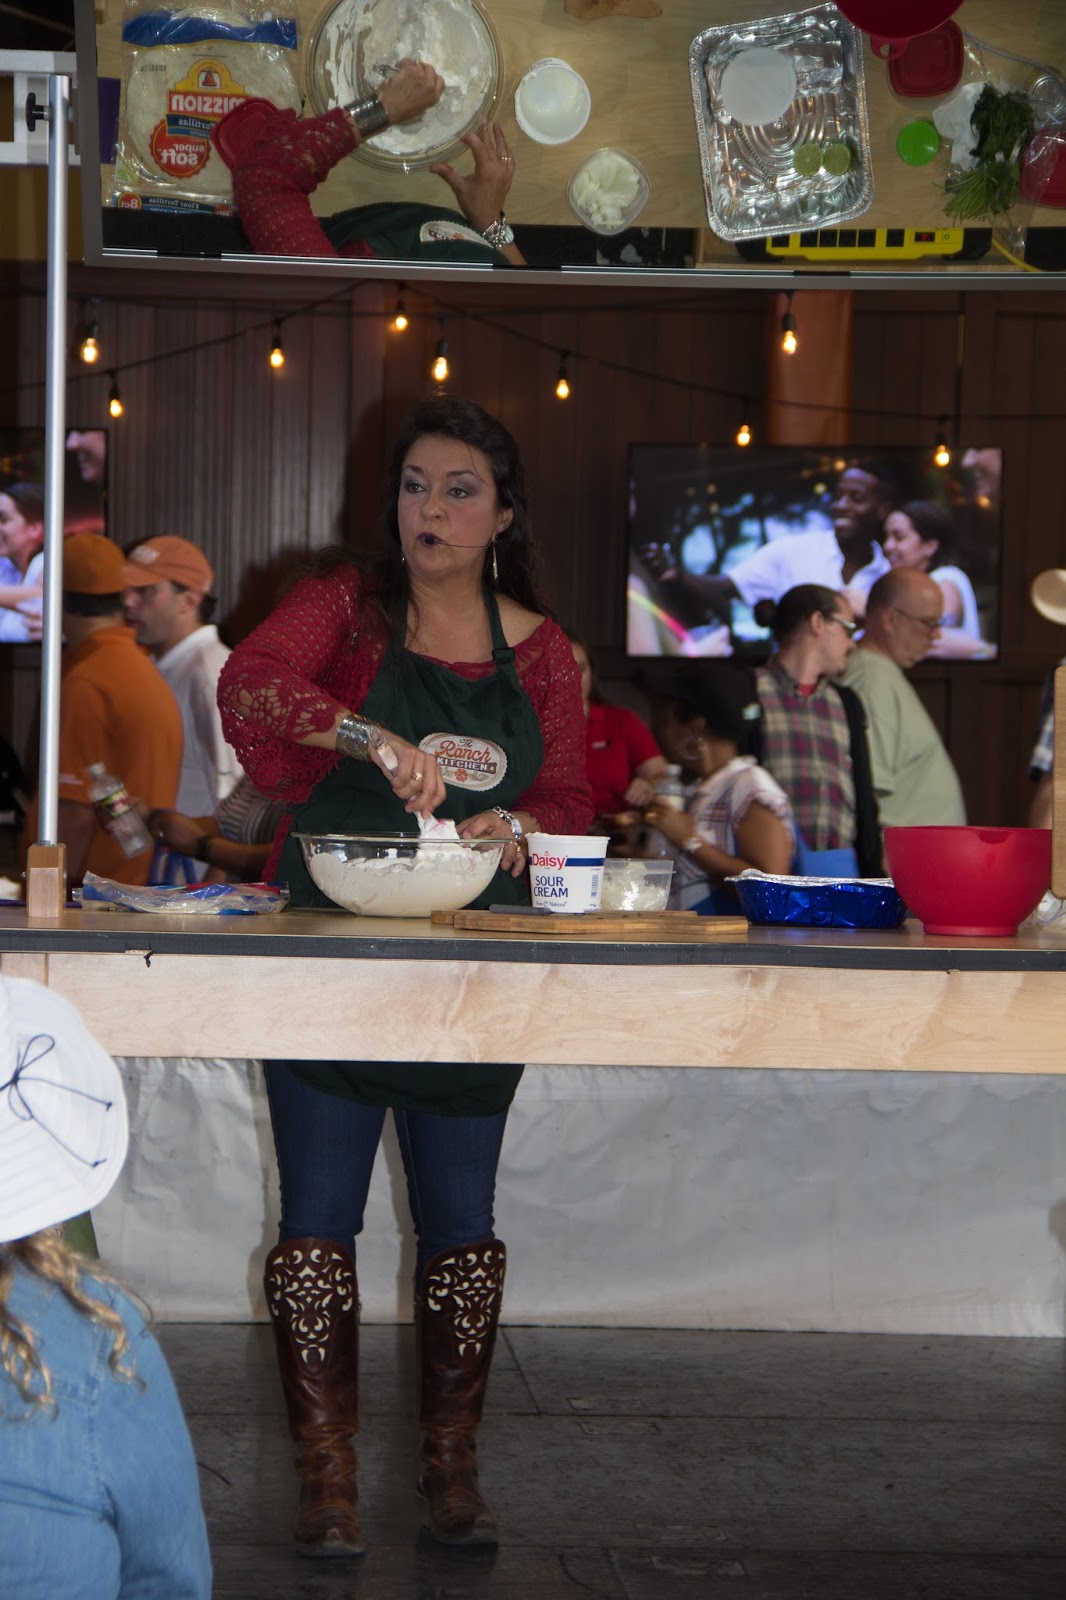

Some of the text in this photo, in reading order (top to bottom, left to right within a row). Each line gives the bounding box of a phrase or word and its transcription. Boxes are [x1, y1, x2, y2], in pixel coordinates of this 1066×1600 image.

[434, 740, 492, 763] Ranch
[437, 757, 488, 771] KITCHEN
[531, 853, 566, 871] Daisy
[535, 875, 564, 887] SOUR
[533, 887, 569, 898] CREAM
